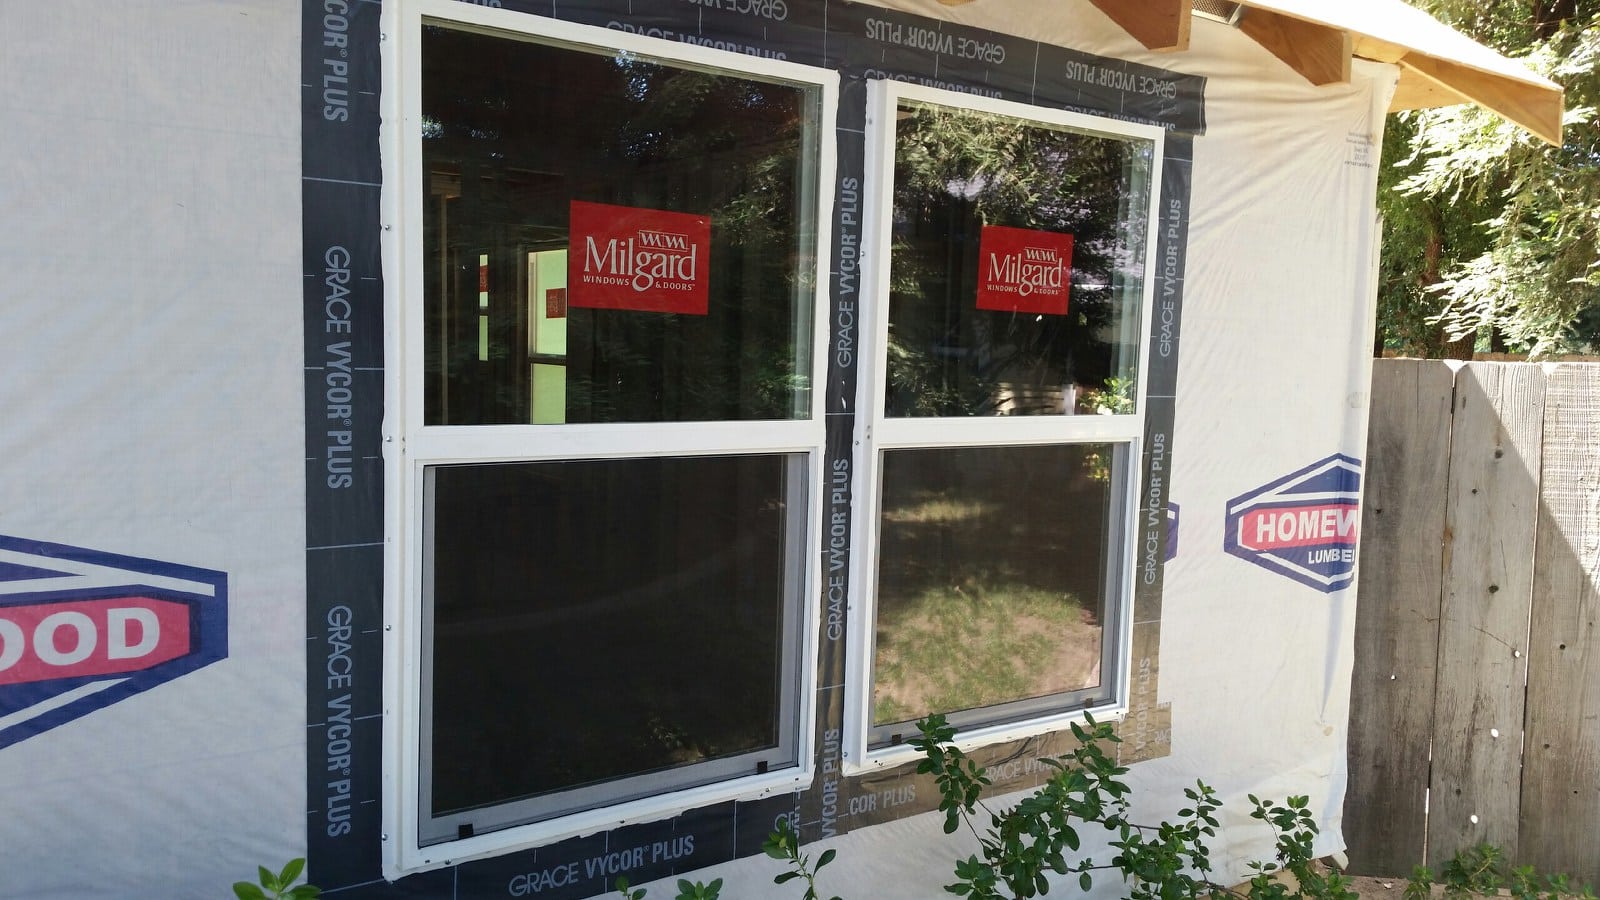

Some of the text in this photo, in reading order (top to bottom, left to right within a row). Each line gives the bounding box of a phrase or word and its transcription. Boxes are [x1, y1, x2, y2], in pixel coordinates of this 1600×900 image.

[865, 18, 902, 44] PLUS
[957, 37, 1006, 64] GRACE
[323, 59, 348, 122] PLUS
[1066, 60, 1095, 84] PLUS
[1139, 76, 1177, 99] GRACE
[841, 176, 858, 226] PLUS
[583, 275, 630, 286] WINDOWS
[584, 235, 697, 292] Milgard
[987, 284, 1018, 293] WINDOWS
[988, 252, 1063, 297] Milgard
[1160, 301, 1174, 357] GRACE
[1168, 199, 1182, 240] PLUS
[325, 245, 352, 334] GRACE
[837, 301, 854, 368] GRACE
[327, 430, 352, 489] PLUS
[832, 458, 849, 504] PLUS
[1145, 531, 1159, 585] GRACE
[1152, 433, 1165, 471] PLUS
[1308, 548, 1355, 565] LUMBE
[827, 575, 844, 641] GRACE
[327, 605, 353, 690] GRACE
[822, 728, 842, 773] PLUS
[327, 778, 351, 838] PLUS
[882, 784, 917, 809] PLUS
[508, 861, 579, 897] GRACE
[652, 835, 695, 864] PLUS
